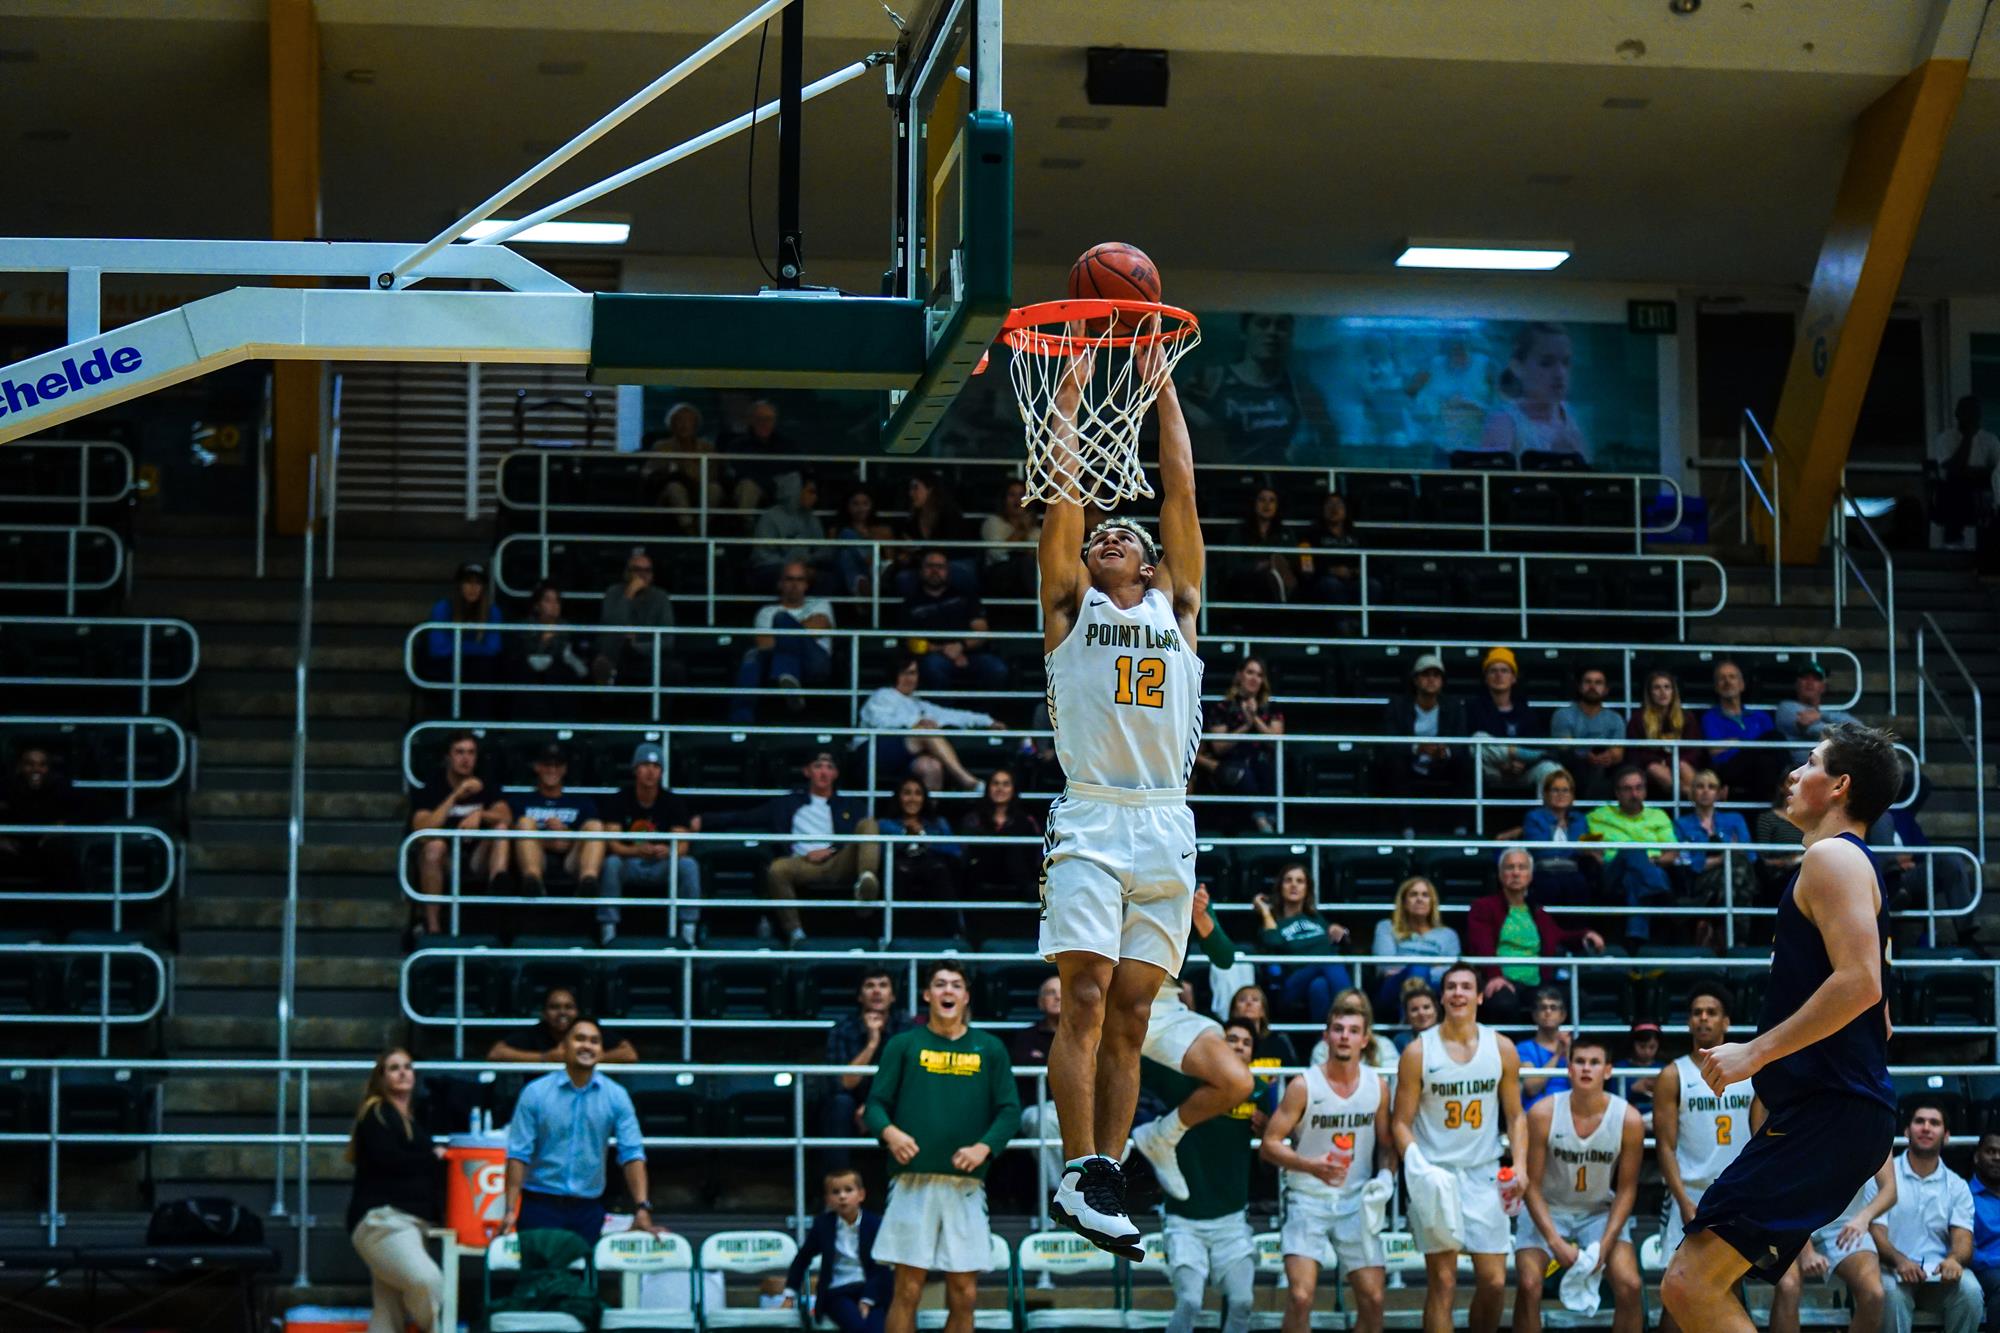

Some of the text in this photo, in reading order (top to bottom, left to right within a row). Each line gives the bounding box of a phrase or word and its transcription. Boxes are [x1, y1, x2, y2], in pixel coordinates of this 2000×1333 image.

[1085, 623, 1141, 648] POINT
[1115, 655, 1166, 709] 12
[1431, 1081, 1464, 1097] POINT
[1688, 1095, 1721, 1112] POINT
[1311, 1114, 1345, 1129] POINT
[1444, 1100, 1483, 1129] 34
[1715, 1115, 1732, 1146] 2
[1554, 1147, 1585, 1164] POINT
[1575, 1165, 1588, 1193] 1
[717, 1238, 783, 1254] POINT LOMA
[1033, 1240, 1094, 1253] POINT LOM
